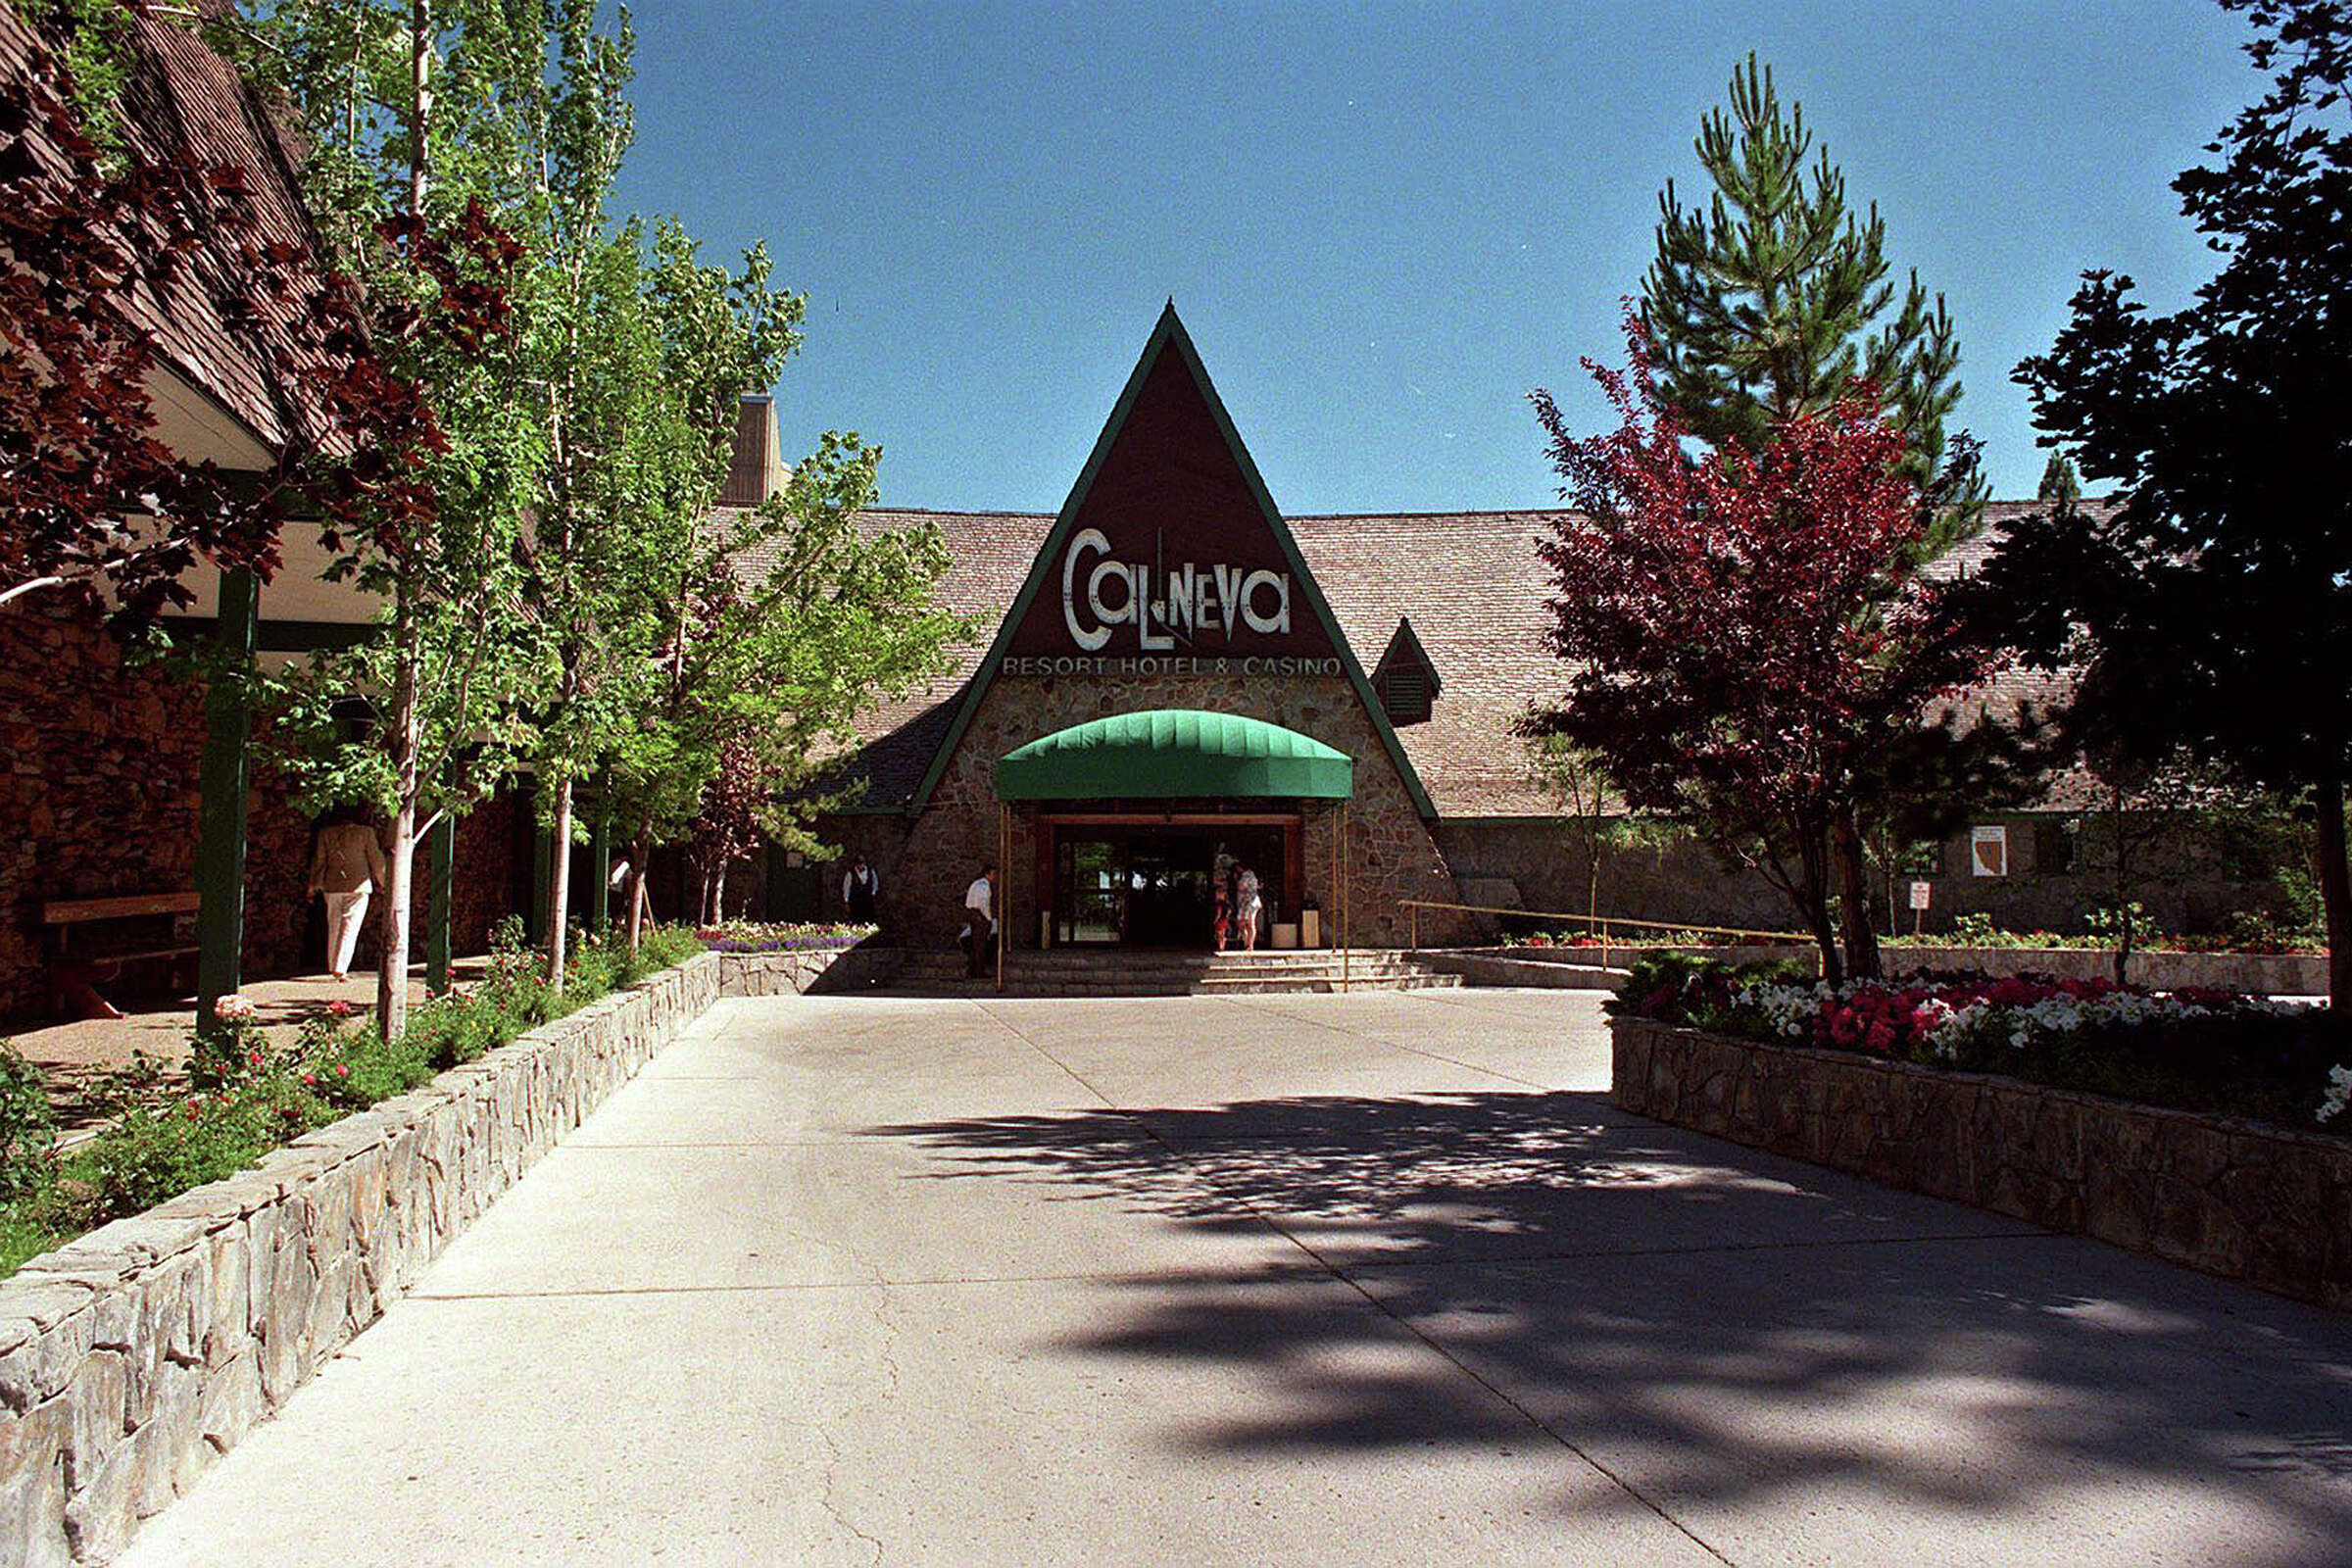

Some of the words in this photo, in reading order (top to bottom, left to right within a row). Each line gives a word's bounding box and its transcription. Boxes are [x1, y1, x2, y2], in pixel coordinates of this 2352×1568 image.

[1003, 657, 1106, 676] RESORT
[1121, 657, 1200, 676] HOTEL
[1215, 657, 1229, 675] &
[1244, 656, 1342, 676] CASINO
